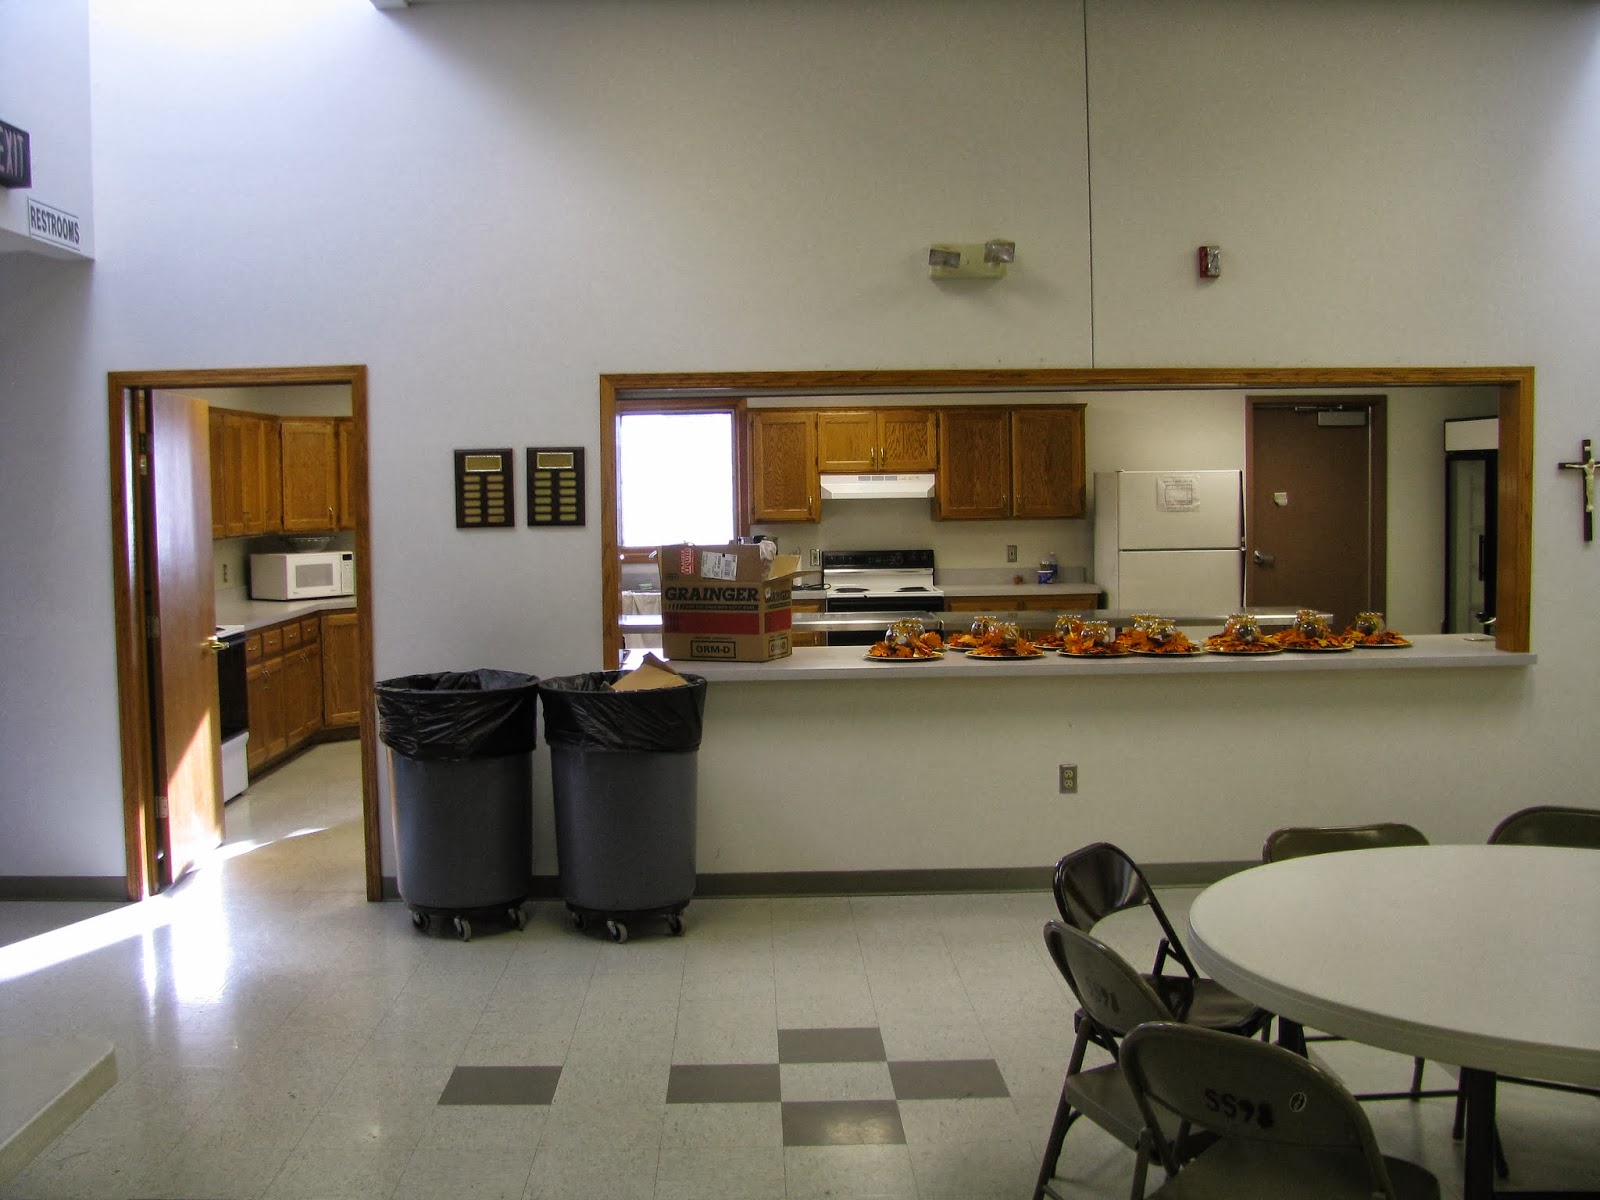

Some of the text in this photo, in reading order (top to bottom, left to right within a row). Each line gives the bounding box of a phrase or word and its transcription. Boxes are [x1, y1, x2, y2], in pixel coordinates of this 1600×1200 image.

[30, 205, 80, 244] RESTROOMS
[665, 586, 759, 602] GRAINGER
[696, 645, 731, 654] ORM-D
